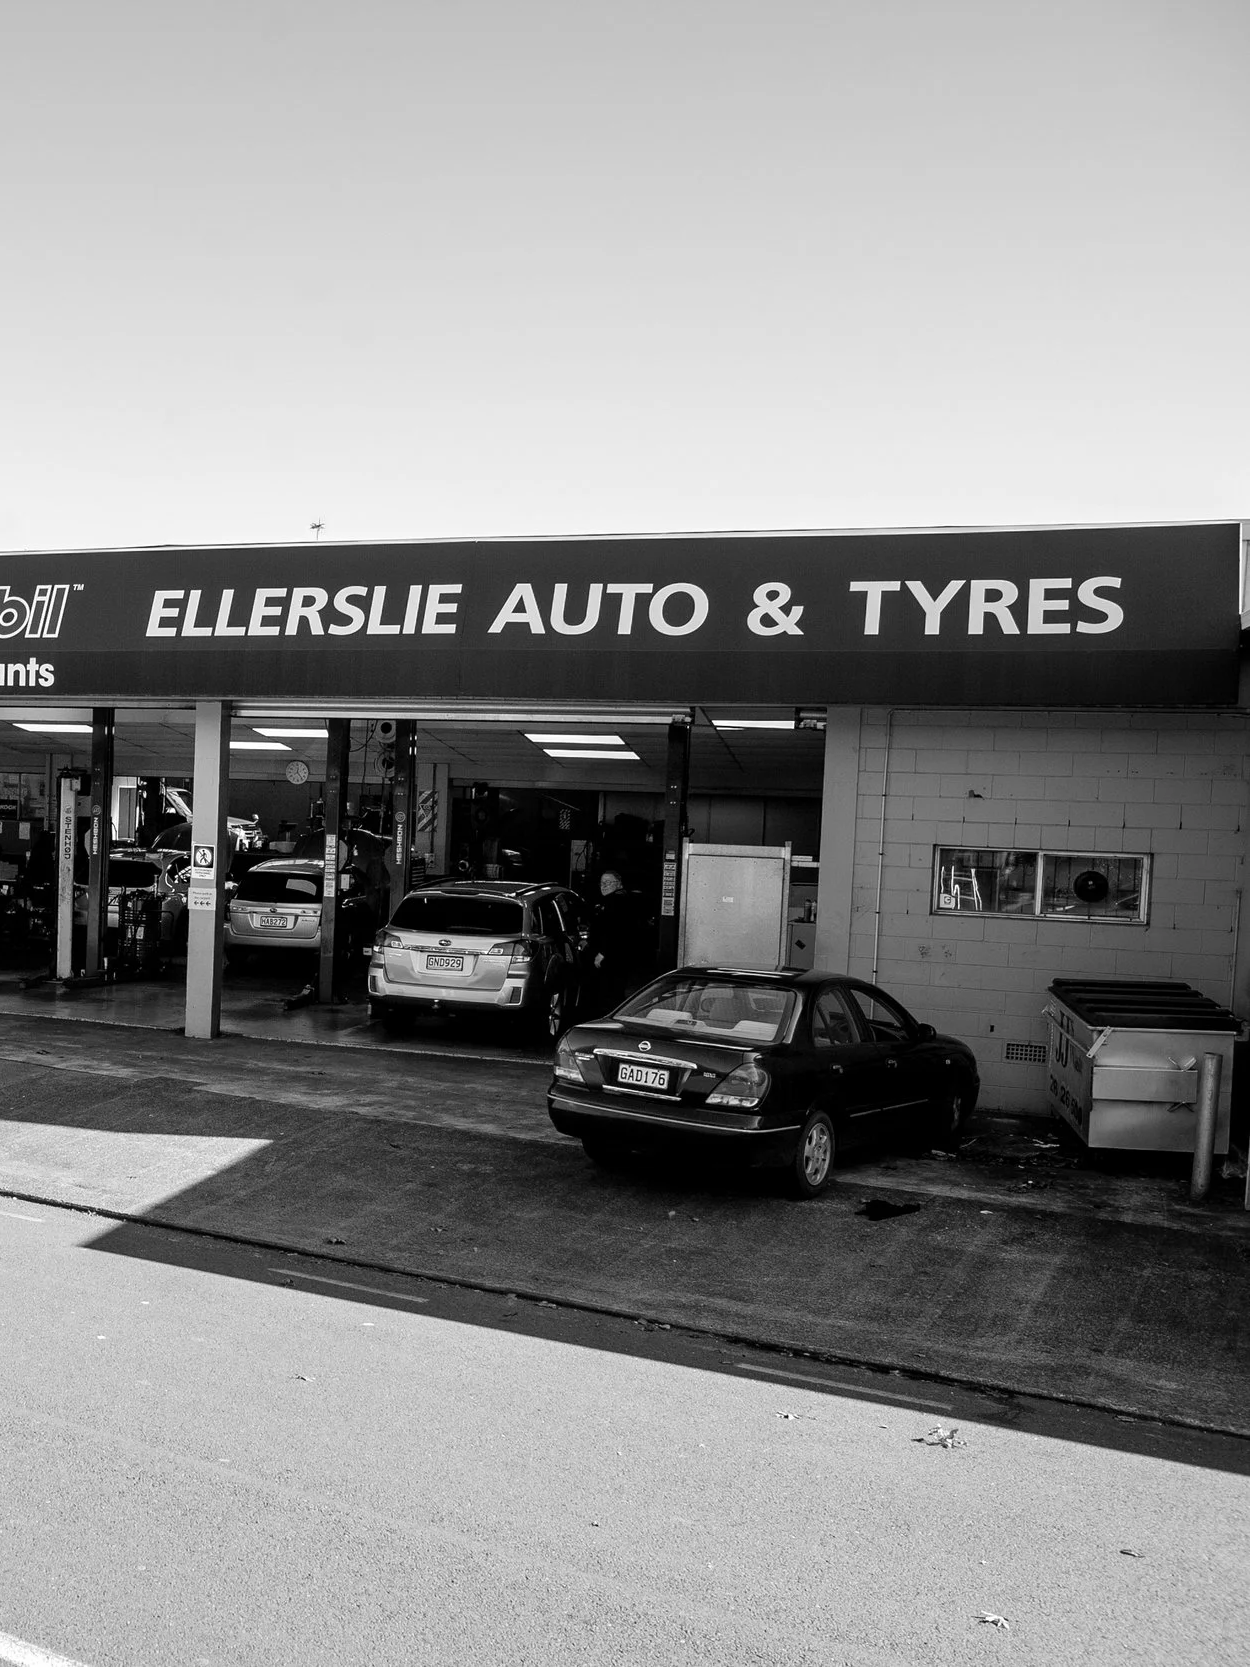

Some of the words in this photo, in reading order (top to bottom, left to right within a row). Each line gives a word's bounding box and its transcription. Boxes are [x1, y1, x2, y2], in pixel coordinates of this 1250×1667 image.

[145, 584, 463, 637] ELLERSLIE
[487, 583, 709, 636] AUTO
[746, 581, 805, 637] &
[849, 576, 1124, 635] TYRES
[427, 956, 462, 969] GND929
[620, 1066, 667, 1087] GAD176
